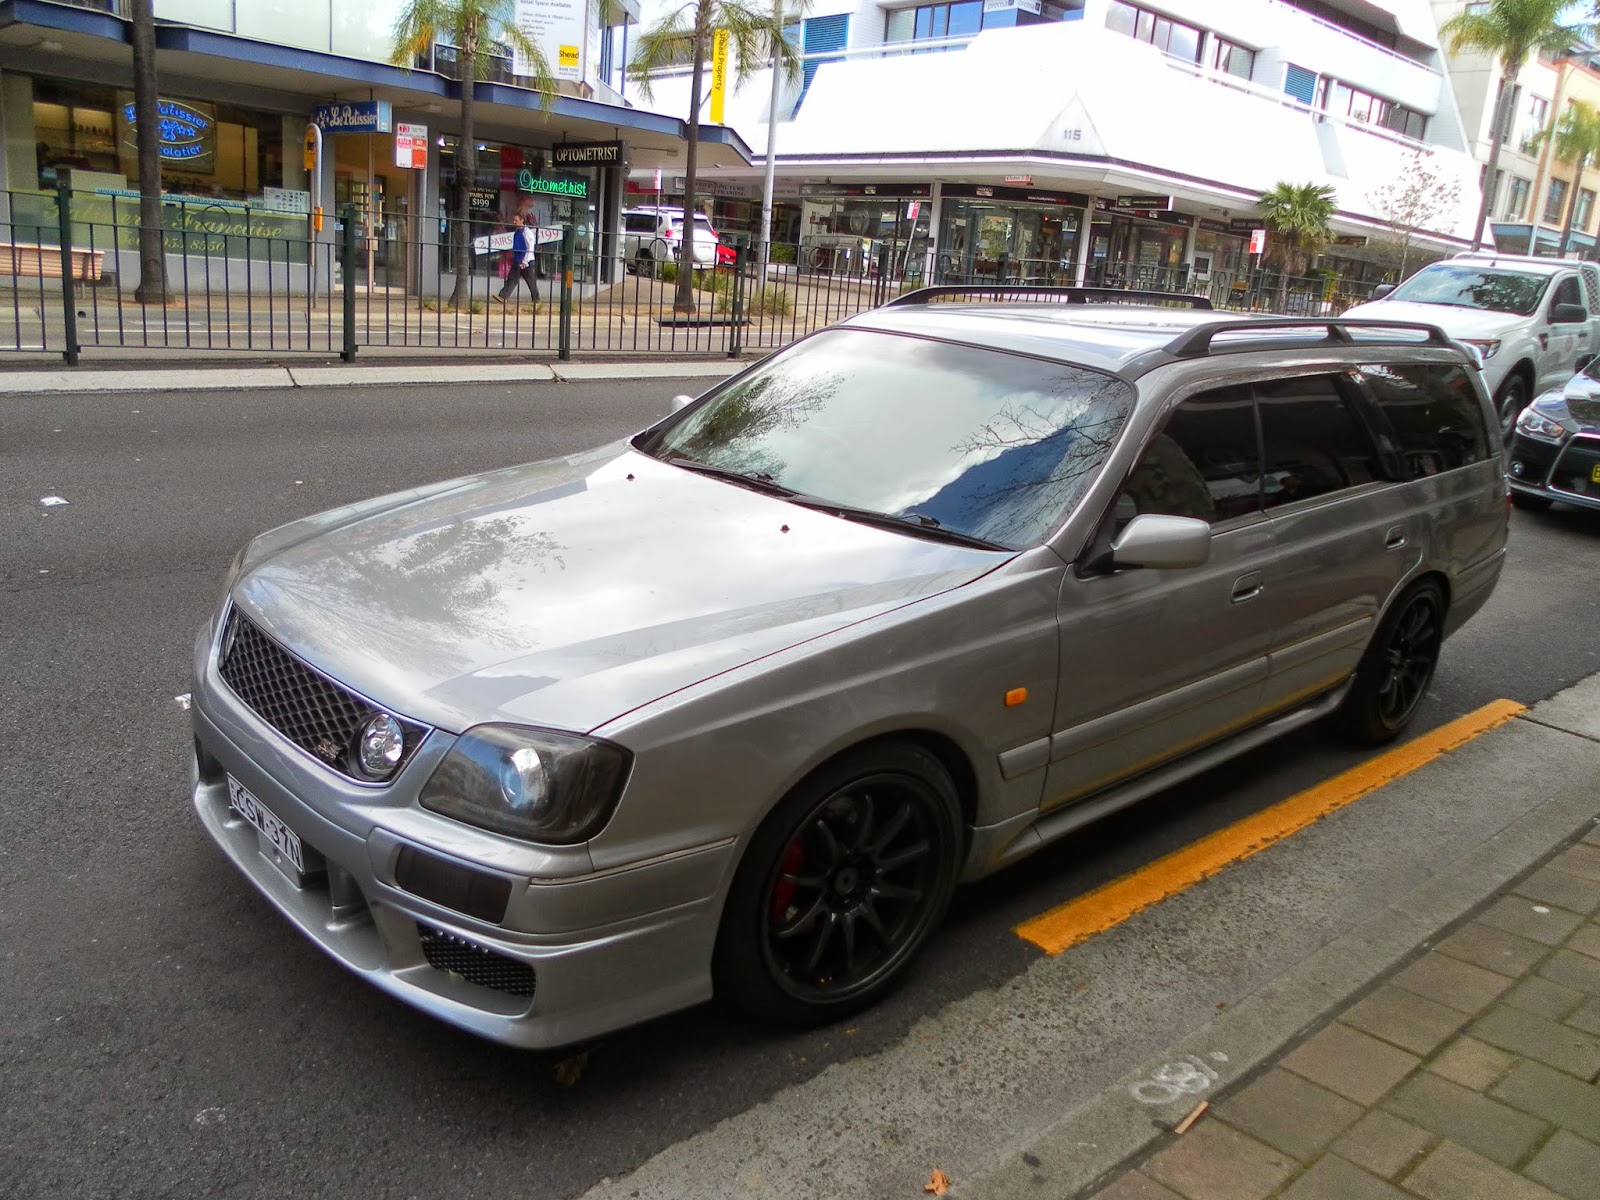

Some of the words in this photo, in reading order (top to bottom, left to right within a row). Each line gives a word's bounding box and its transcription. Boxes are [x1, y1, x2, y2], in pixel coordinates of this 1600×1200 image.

[559, 50, 579, 60] Shead
[714, 57, 725, 91] Property
[330, 106, 343, 127] Le
[342, 105, 377, 127] Patissier
[1063, 129, 1082, 141] 115
[556, 146, 619, 162] OPTOMETRIST
[520, 169, 587, 196] Optometrist
[472, 198, 490, 208] $199
[490, 236, 513, 247] PAIRS
